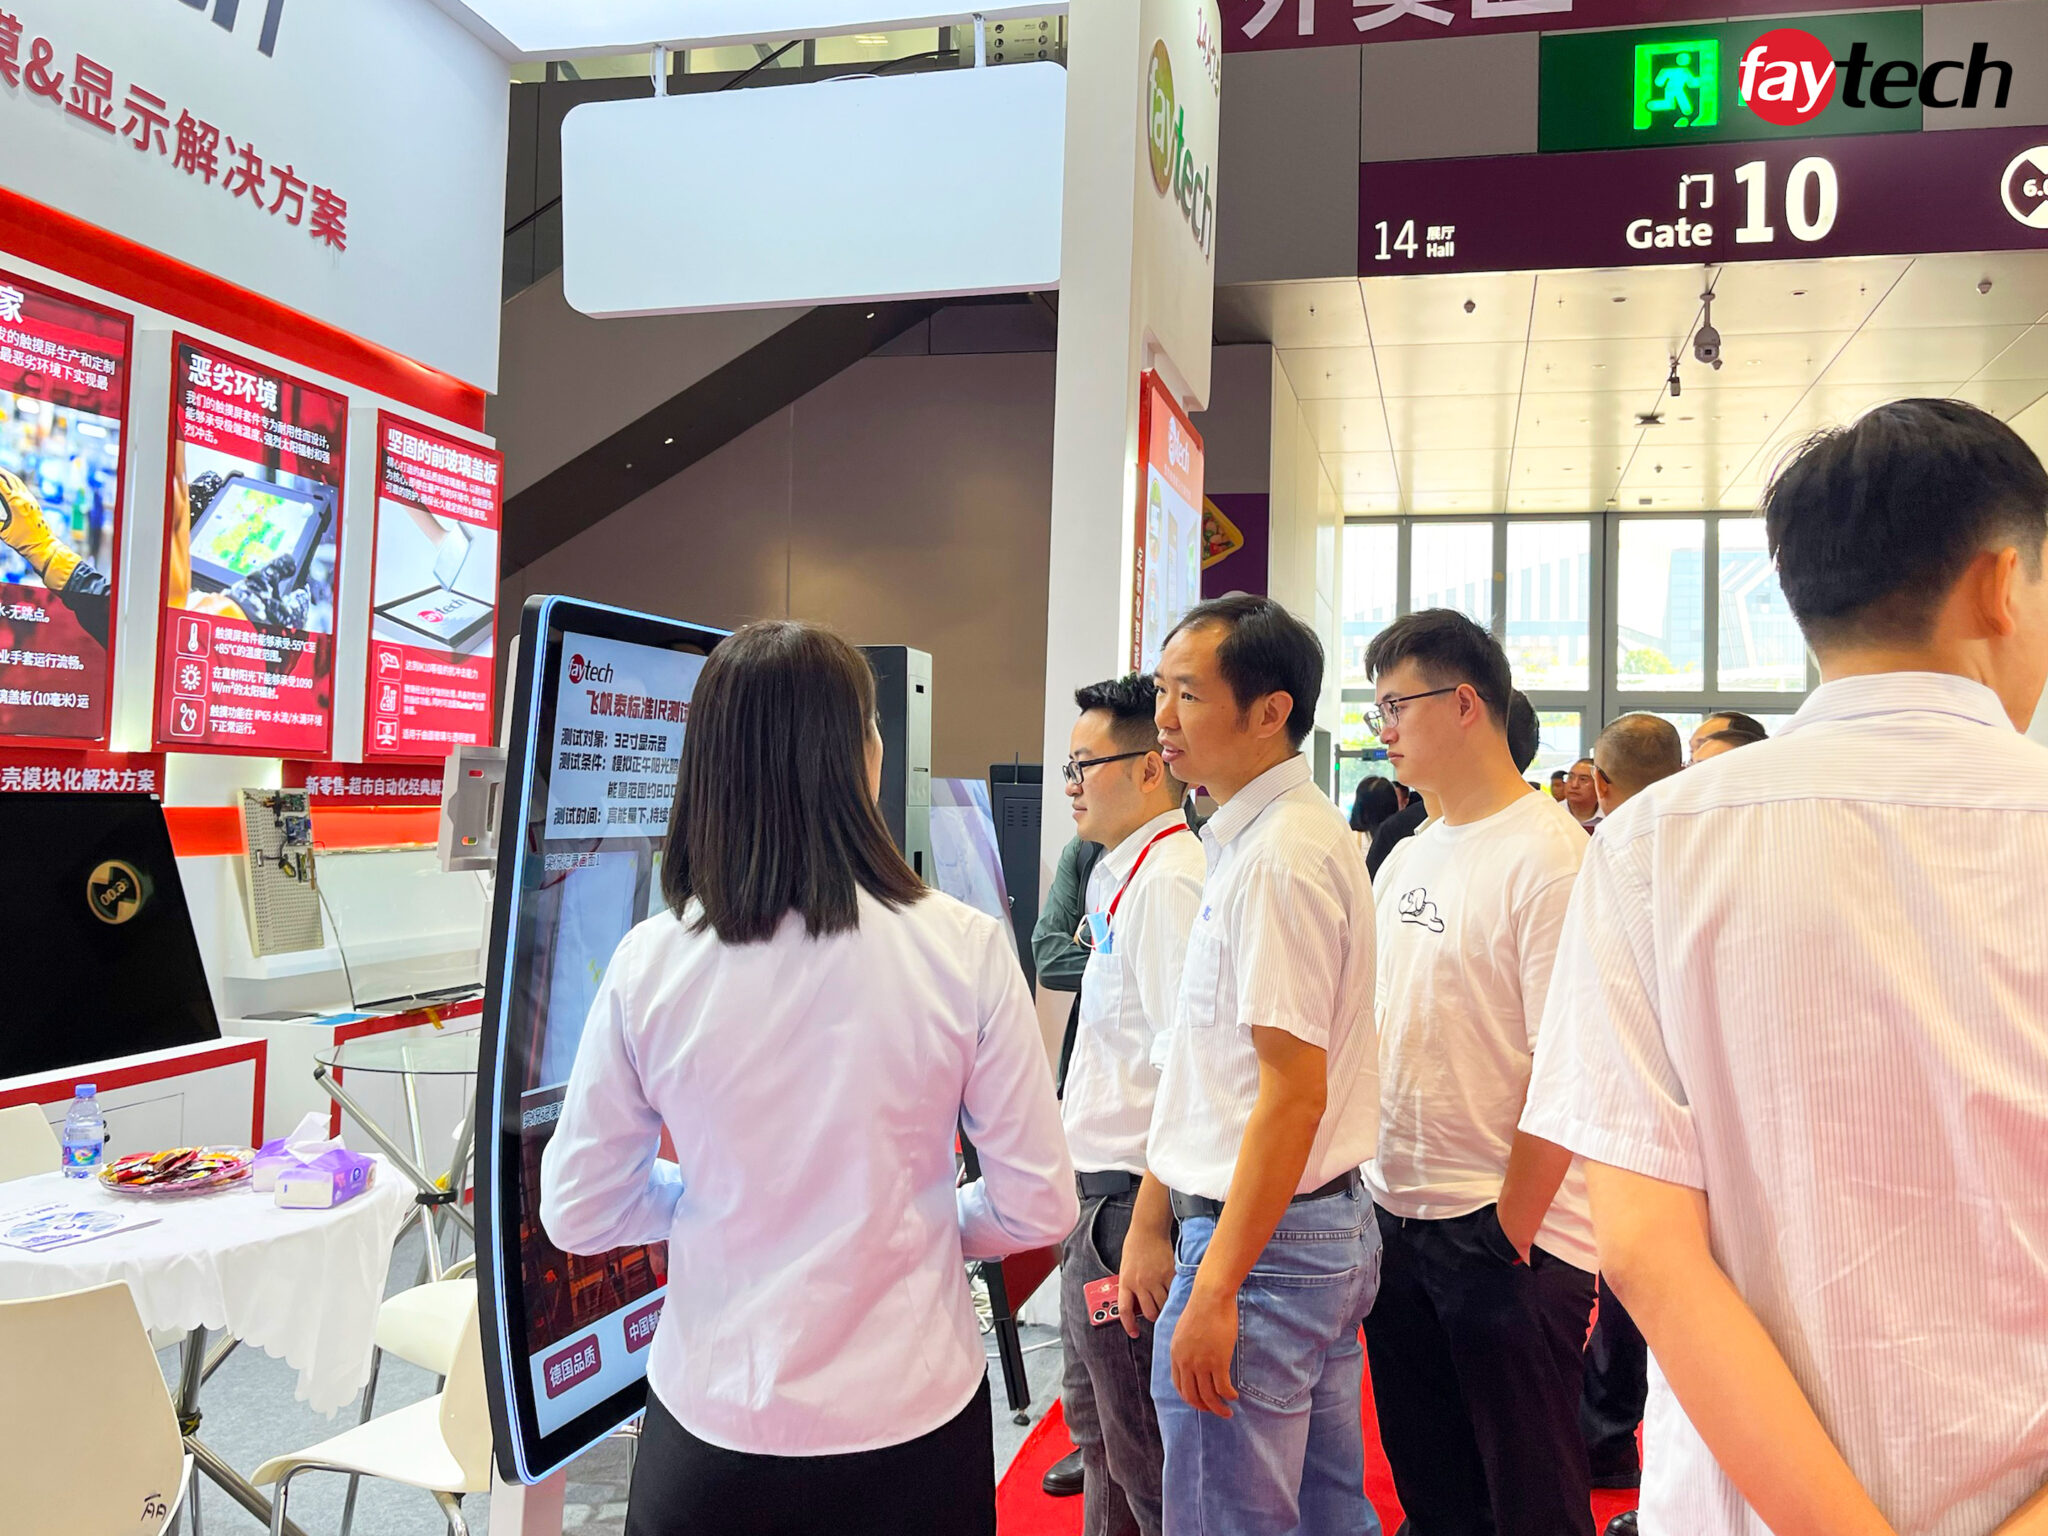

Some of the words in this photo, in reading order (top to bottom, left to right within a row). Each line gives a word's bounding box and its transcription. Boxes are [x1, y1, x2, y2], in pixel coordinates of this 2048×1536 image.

[1147, 38, 1213, 262] faytech
[1626, 219, 1713, 249] Gate
[1735, 157, 1838, 244] 10
[1678, 173, 1714, 210] 门
[1374, 219, 1419, 260] 14
[1426, 226, 1455, 241] 展厅
[1426, 241, 1455, 258] Hall
[188, 354, 278, 412] 恶劣环境
[387, 428, 498, 485] 坚固的前玻璃盖板
[568, 653, 614, 684] faytech
[0, 766, 155, 791] 壳模块化解决方案
[306, 776, 444, 797] 新零售-超市自动化经典解
[549, 1345, 596, 1388] 德国品质
